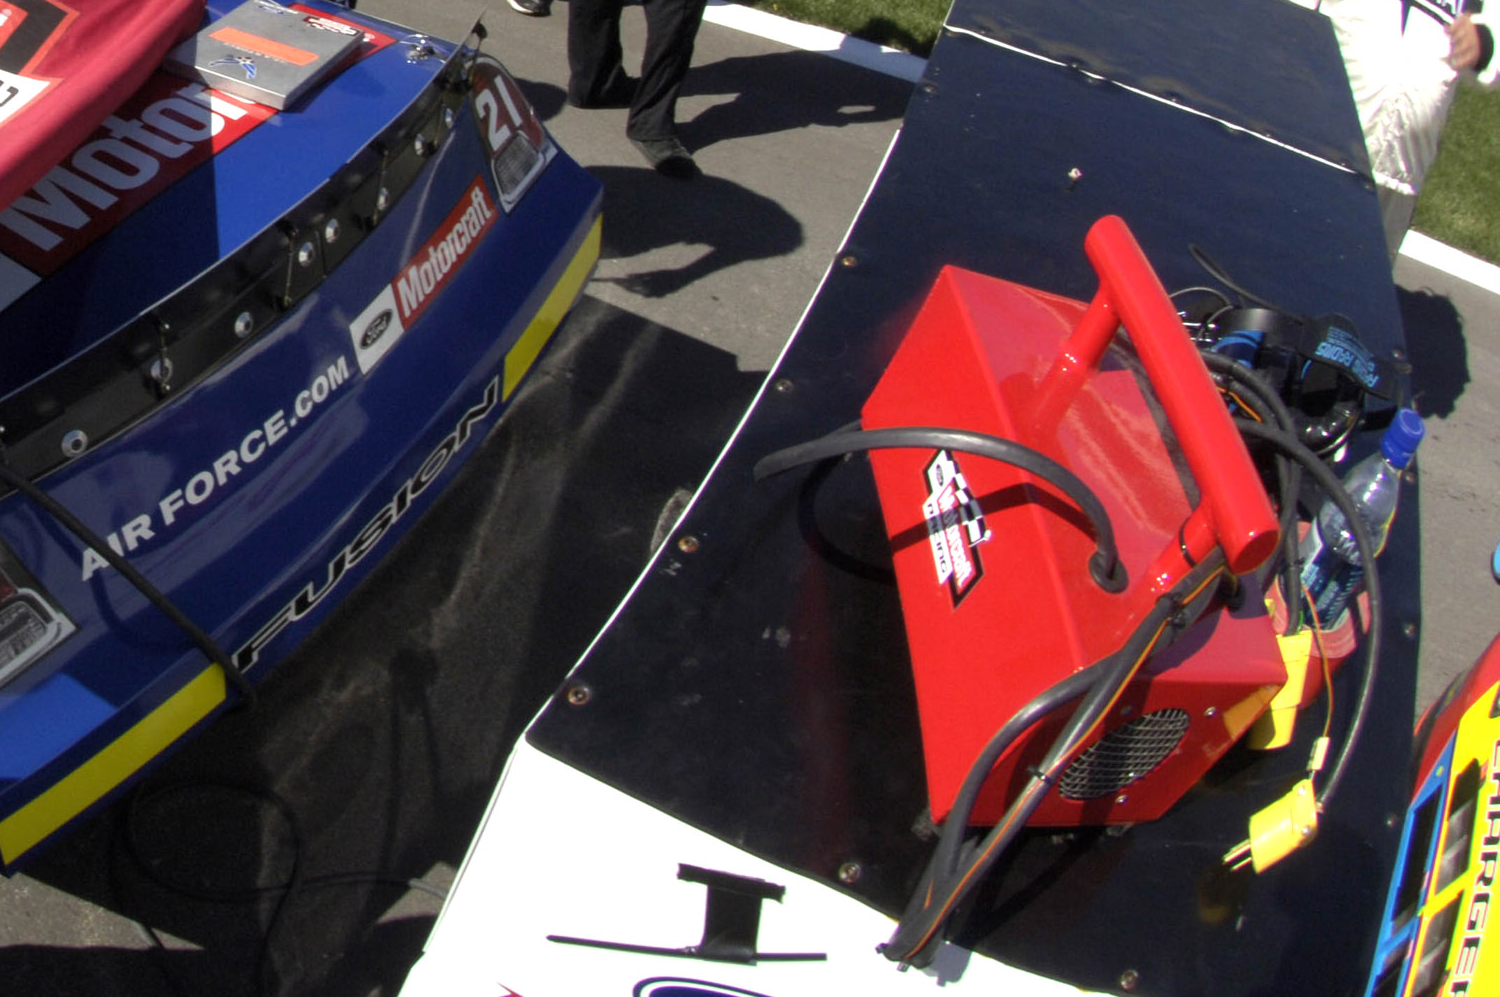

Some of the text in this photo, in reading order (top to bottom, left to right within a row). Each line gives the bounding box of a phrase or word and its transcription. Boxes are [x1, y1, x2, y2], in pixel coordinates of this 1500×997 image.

[475, 74, 523, 152] 21
[396, 184, 493, 318] Motorcraft
[81, 356, 351, 582] AIR FORCE.COM
[233, 375, 498, 673] FUSION
